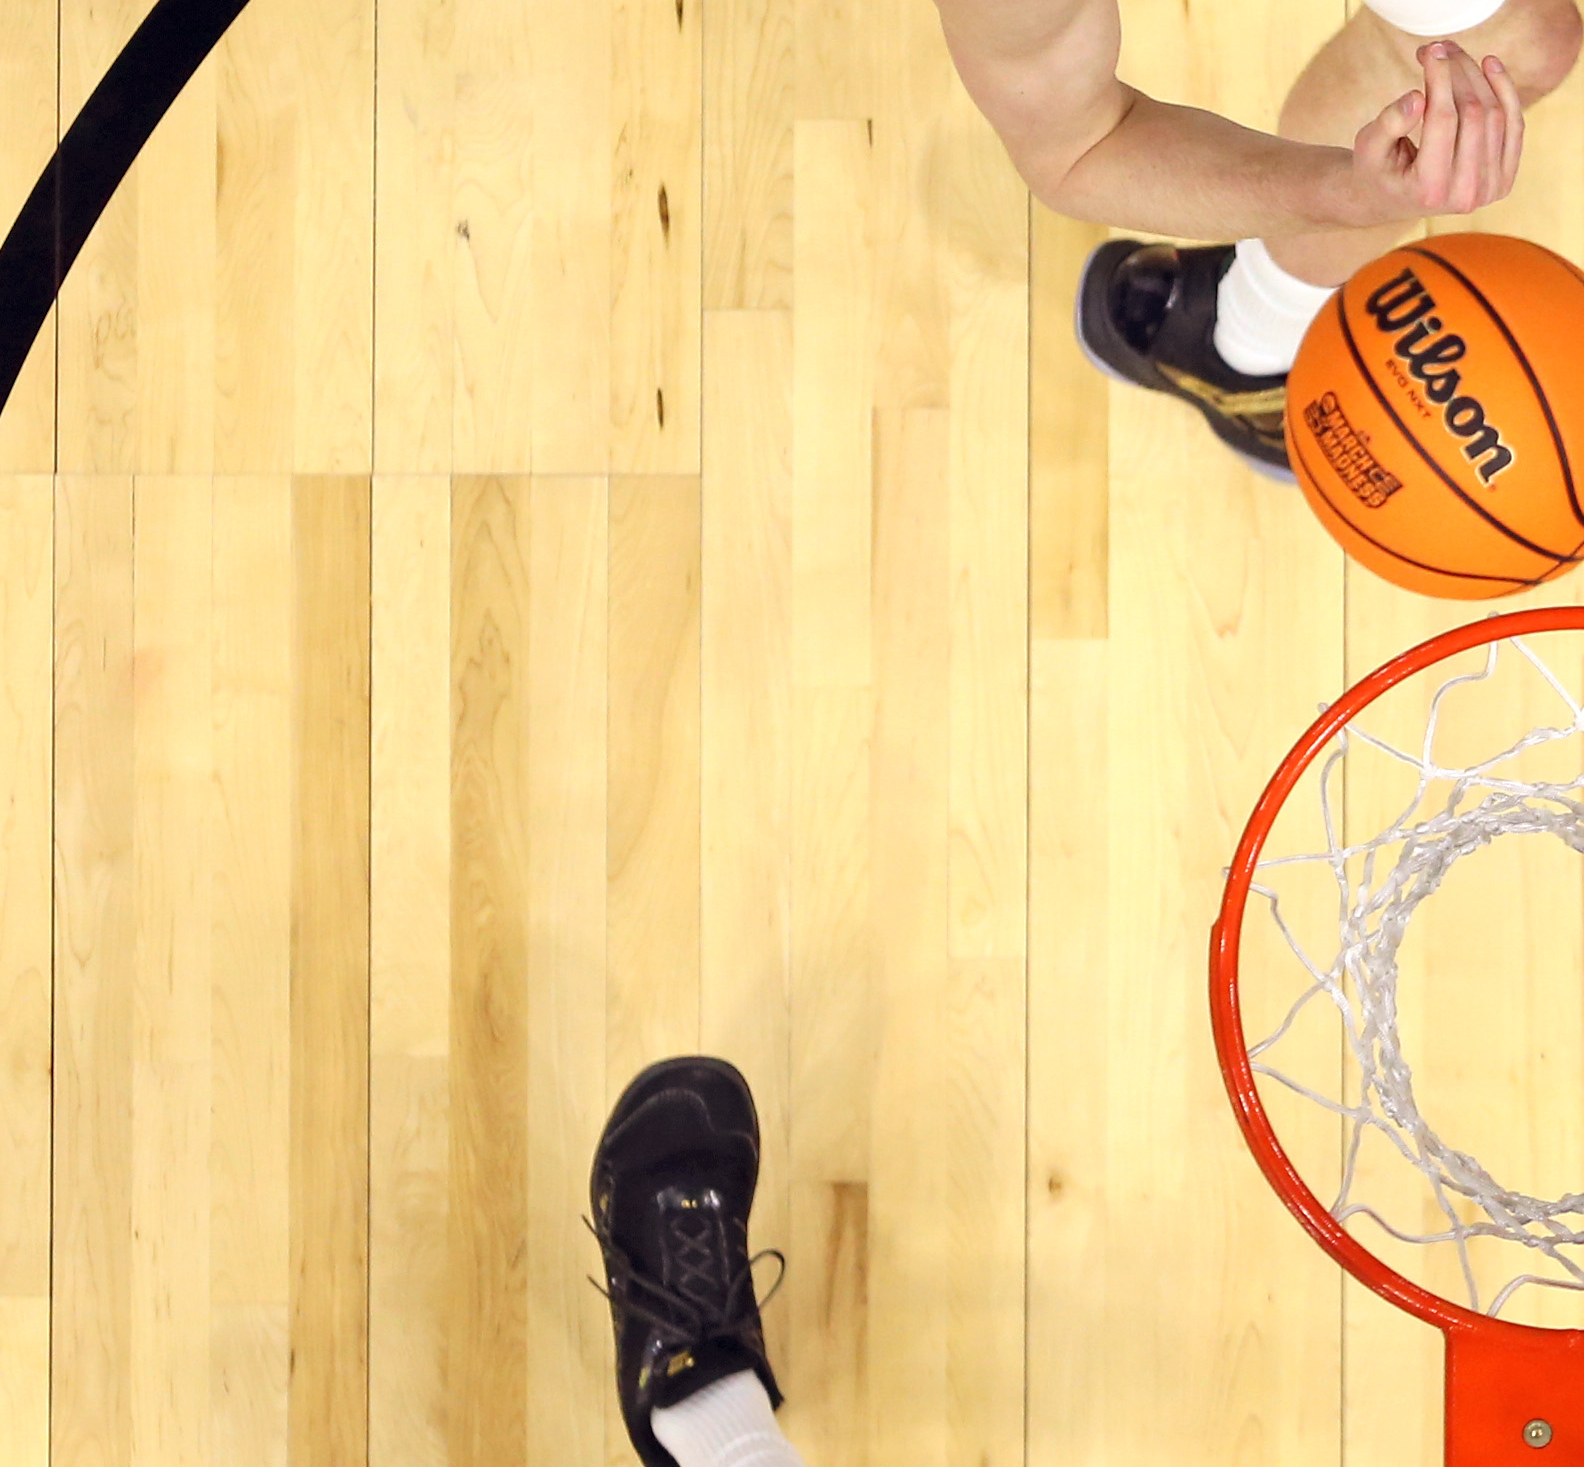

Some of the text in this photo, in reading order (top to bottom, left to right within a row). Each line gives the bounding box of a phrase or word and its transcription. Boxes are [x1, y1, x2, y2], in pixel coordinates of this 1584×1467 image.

[1364, 266, 1514, 486] Wilson
[1384, 358, 1432, 420] EVO NXT
[1319, 429, 1388, 506] MADNESS
[1326, 410, 1376, 472] MARCH
